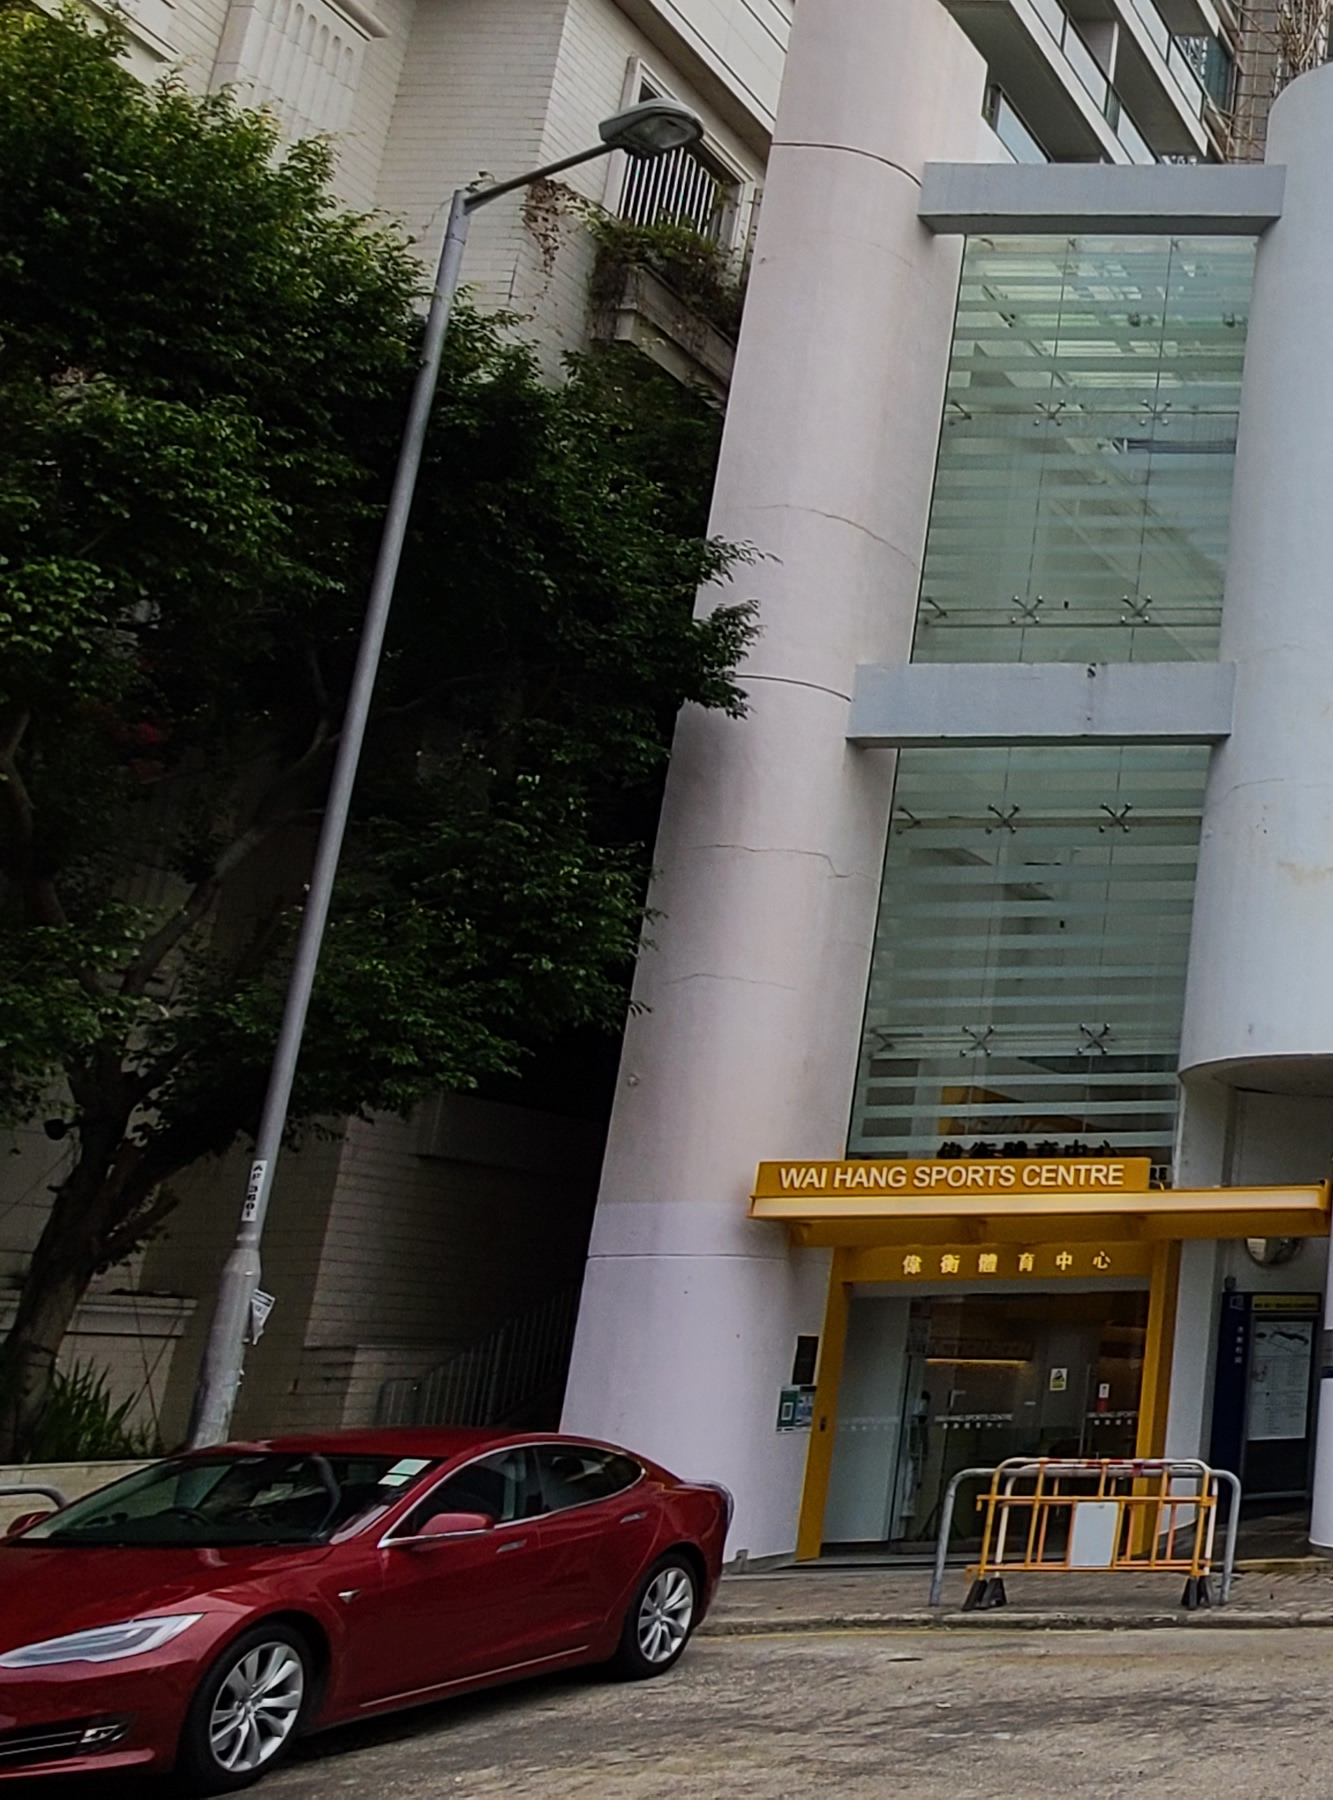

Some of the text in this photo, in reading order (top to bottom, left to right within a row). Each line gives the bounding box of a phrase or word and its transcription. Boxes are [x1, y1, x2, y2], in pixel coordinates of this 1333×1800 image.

[780, 1167, 827, 1190] WAI
[834, 1165, 908, 1189] HANG
[912, 1164, 1016, 1188] SPORTS
[1021, 1163, 1125, 1187] CENTRE
[902, 1250, 1112, 1275] 偉衡體育中心
